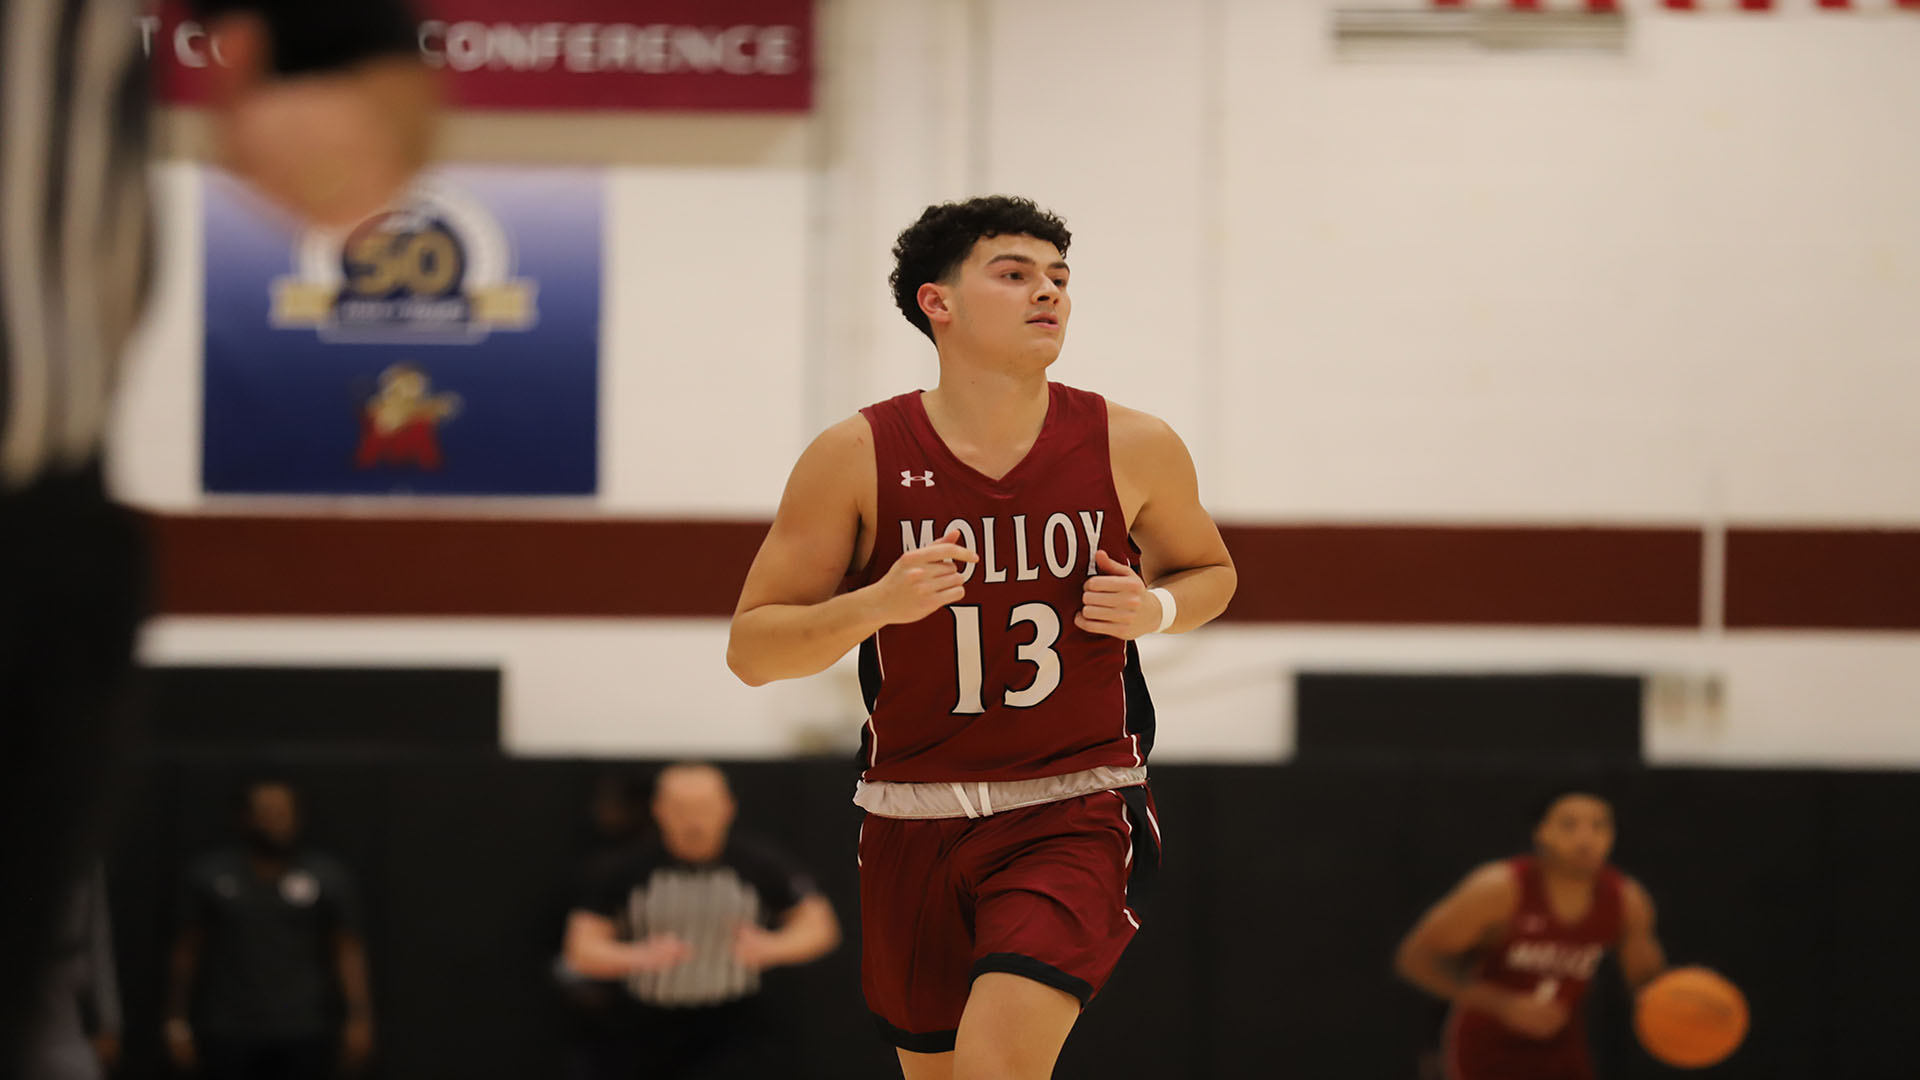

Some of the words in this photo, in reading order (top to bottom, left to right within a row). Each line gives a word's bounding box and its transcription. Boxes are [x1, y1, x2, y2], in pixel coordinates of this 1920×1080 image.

[417, 20, 799, 75] CONFERENCE
[346, 228, 464, 298] 50
[949, 602, 1064, 715] 13
